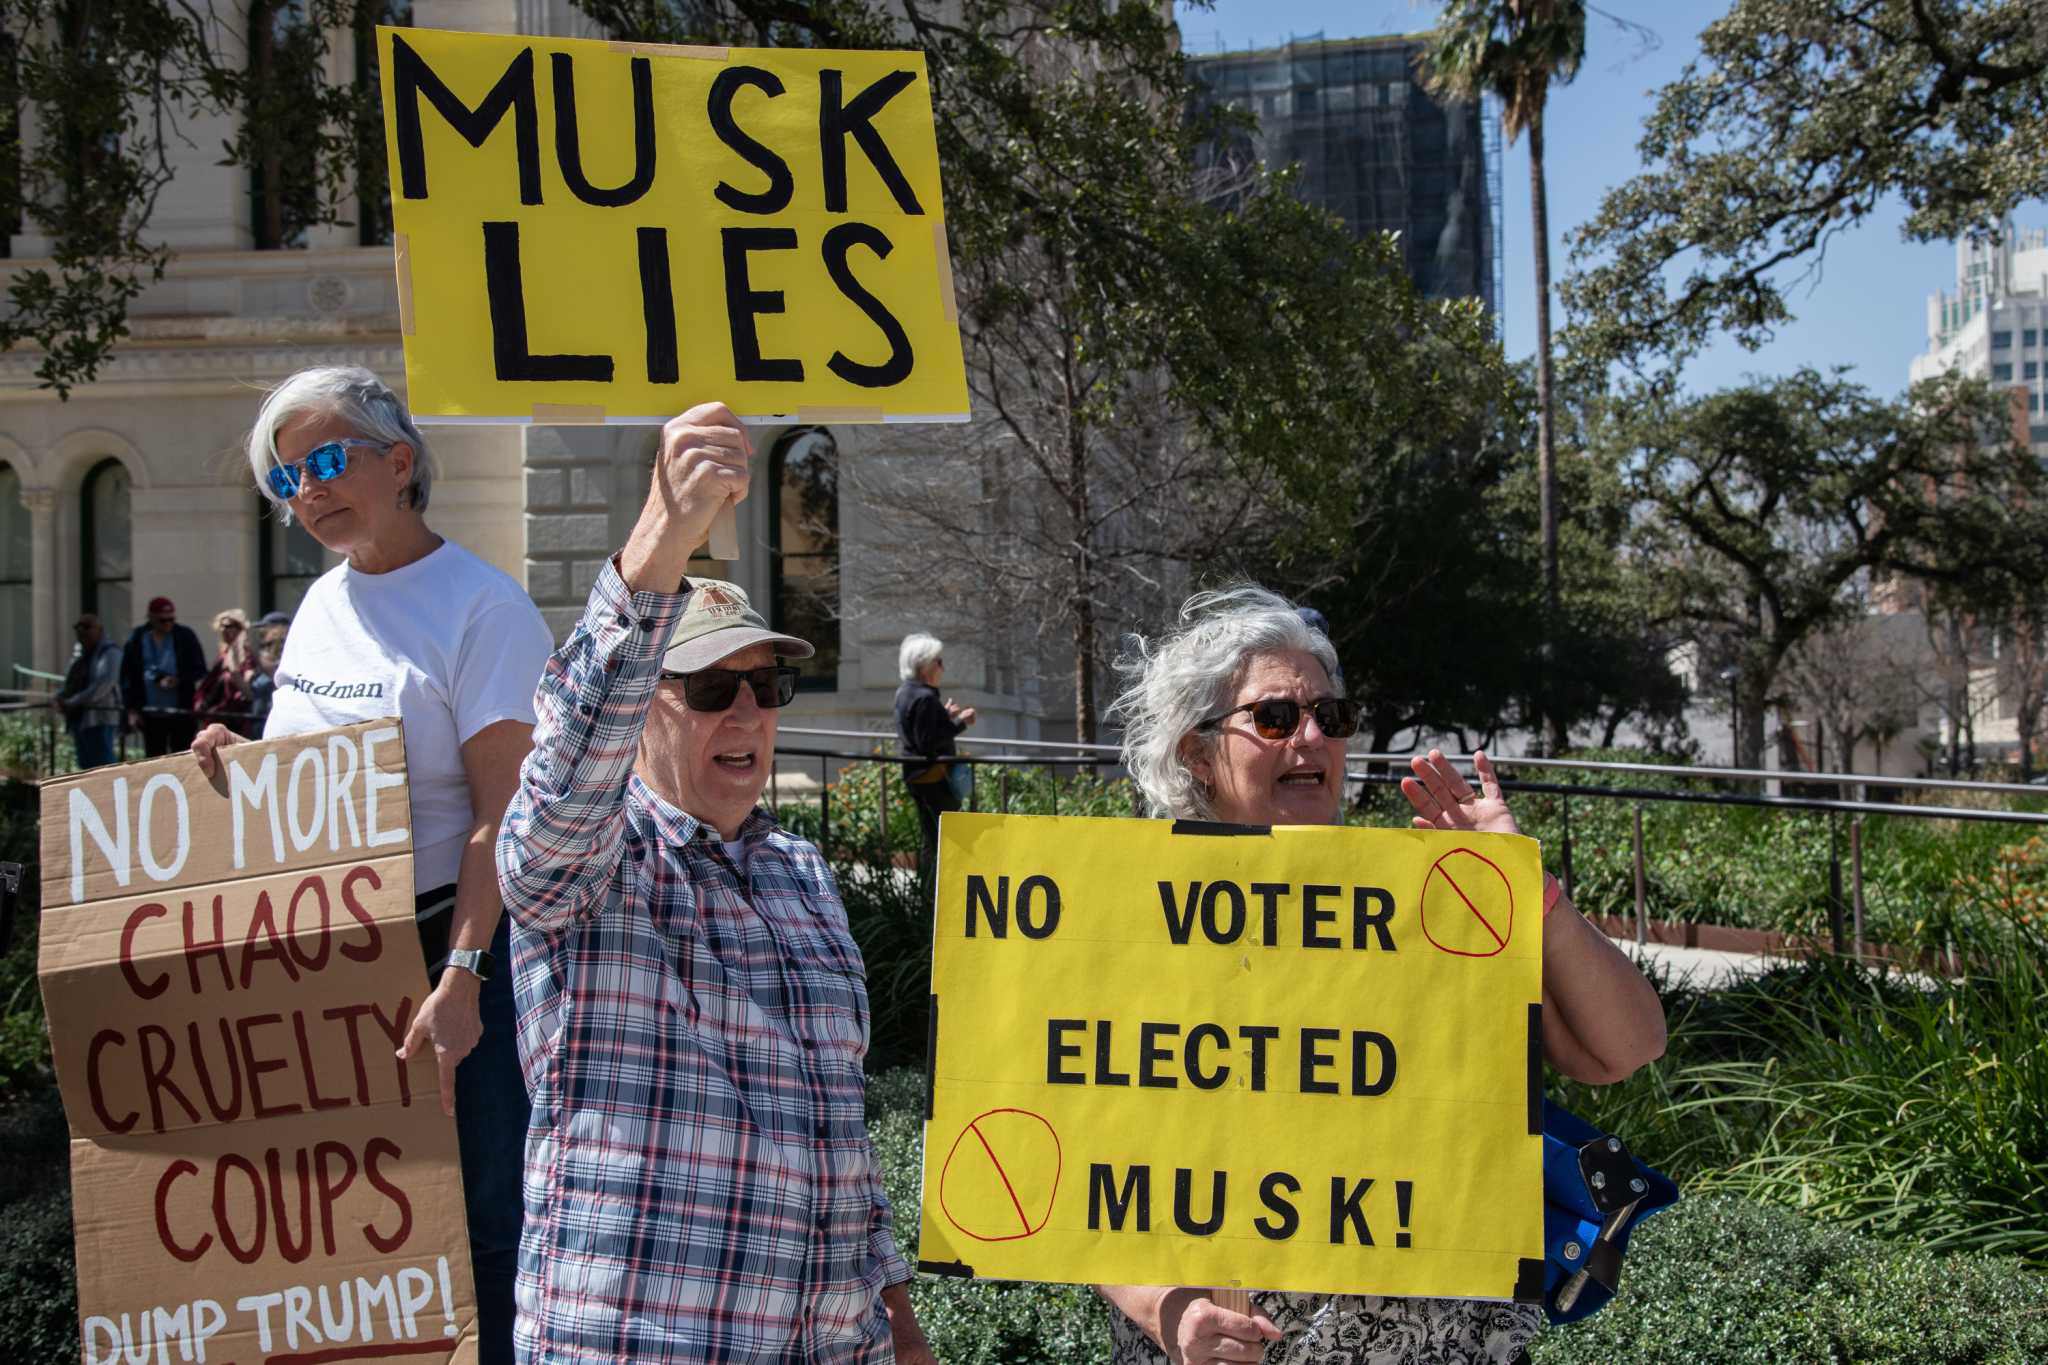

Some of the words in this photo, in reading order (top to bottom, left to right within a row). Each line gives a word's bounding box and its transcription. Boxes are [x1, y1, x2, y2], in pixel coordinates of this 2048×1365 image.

[392, 33, 925, 215] MUSK
[483, 222, 914, 388] LIES
[69, 773, 190, 902] NO
[229, 727, 409, 869] MORE
[118, 866, 383, 999] CHAOS
[965, 875, 1060, 939] NO
[1158, 880, 1397, 951] VOTER
[87, 996, 413, 1134] CRUELTY
[1046, 1019, 1398, 1096] ELECTED
[154, 1137, 413, 1264] COUPS
[1087, 1164, 1413, 1248] MUSK!
[84, 1299, 227, 1365] DUMP
[237, 1256, 459, 1353] TRUMP!
